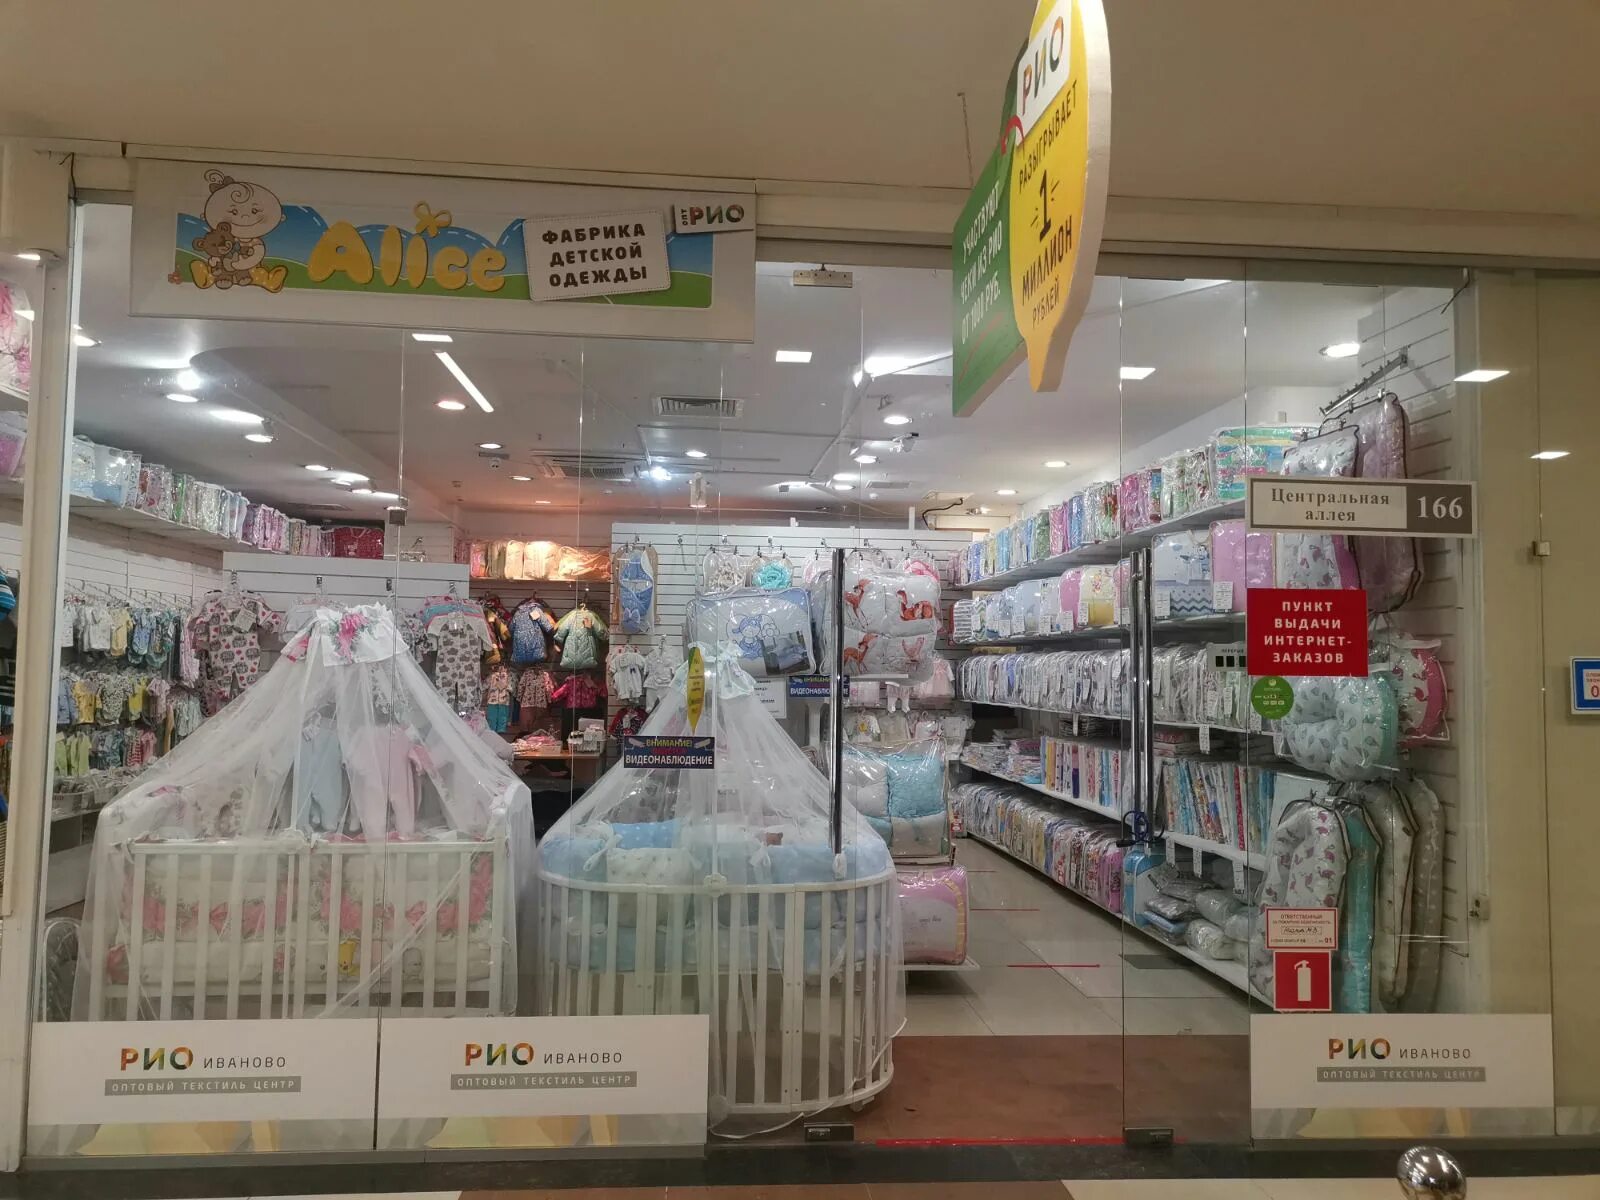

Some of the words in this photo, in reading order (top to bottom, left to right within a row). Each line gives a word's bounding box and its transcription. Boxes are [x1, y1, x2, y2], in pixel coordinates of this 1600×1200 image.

[1022, 15, 1065, 115] РИО
[1019, 79, 1077, 194] РАЗЫГРЫВАЕТ
[680, 208, 689, 226] ОПТ
[689, 204, 745, 226] РИО
[1039, 169, 1052, 242] 1
[962, 180, 1000, 264] УЧАСТВУЮТ
[541, 223, 647, 246] ФАБРИКА
[306, 203, 507, 293] Alice
[549, 241, 645, 269] ДЕТСКОЙ
[960, 260, 978, 305] ЧЕКИ
[977, 244, 988, 282] ИЗ
[987, 219, 1003, 265] РИО
[1021, 214, 1073, 306] МИЛЛИОН
[549, 264, 648, 288] ОДЕЖДЫ
[1032, 282, 1061, 329] РУБЛЕЙ
[1271, 487, 1391, 507] Центральная
[1415, 496, 1464, 520] 166
[1304, 508, 1356, 523] аллея
[1281, 600, 1334, 613] ПУНКТ
[1274, 617, 1342, 632] ВЫДАЧИ
[1263, 635, 1353, 648] ИНТЕРНЕТ-
[1272, 651, 1344, 664] ЗАКАЗОВ
[625, 754, 713, 766] ВИДЕОНАБЛЮДЕНИЕ
[120, 1047, 194, 1072] РИО
[203, 1056, 287, 1070] ИВАНОВО
[463, 1042, 536, 1067] РИО
[543, 1051, 623, 1065] ИВАНОВО
[1328, 1037, 1391, 1060] РИО
[1399, 1048, 1472, 1060] ИВАНОВО
[457, 1075, 517, 1088] ОПТОВЫЙ
[523, 1075, 586, 1088] ТЕКСТИЛЬ
[590, 1074, 632, 1088] ЦЕНТР
[1323, 1068, 1377, 1080] ОПТОВЫЙ
[1382, 1068, 1439, 1080] ТЕКСТИЛЬ
[1444, 1068, 1481, 1080] ЦЕНТР
[111, 1080, 176, 1094] ОПТОВЫЙ
[181, 1080, 248, 1093] ТЕКСТИЛЬ
[253, 1079, 295, 1093] ЦЕНТР
